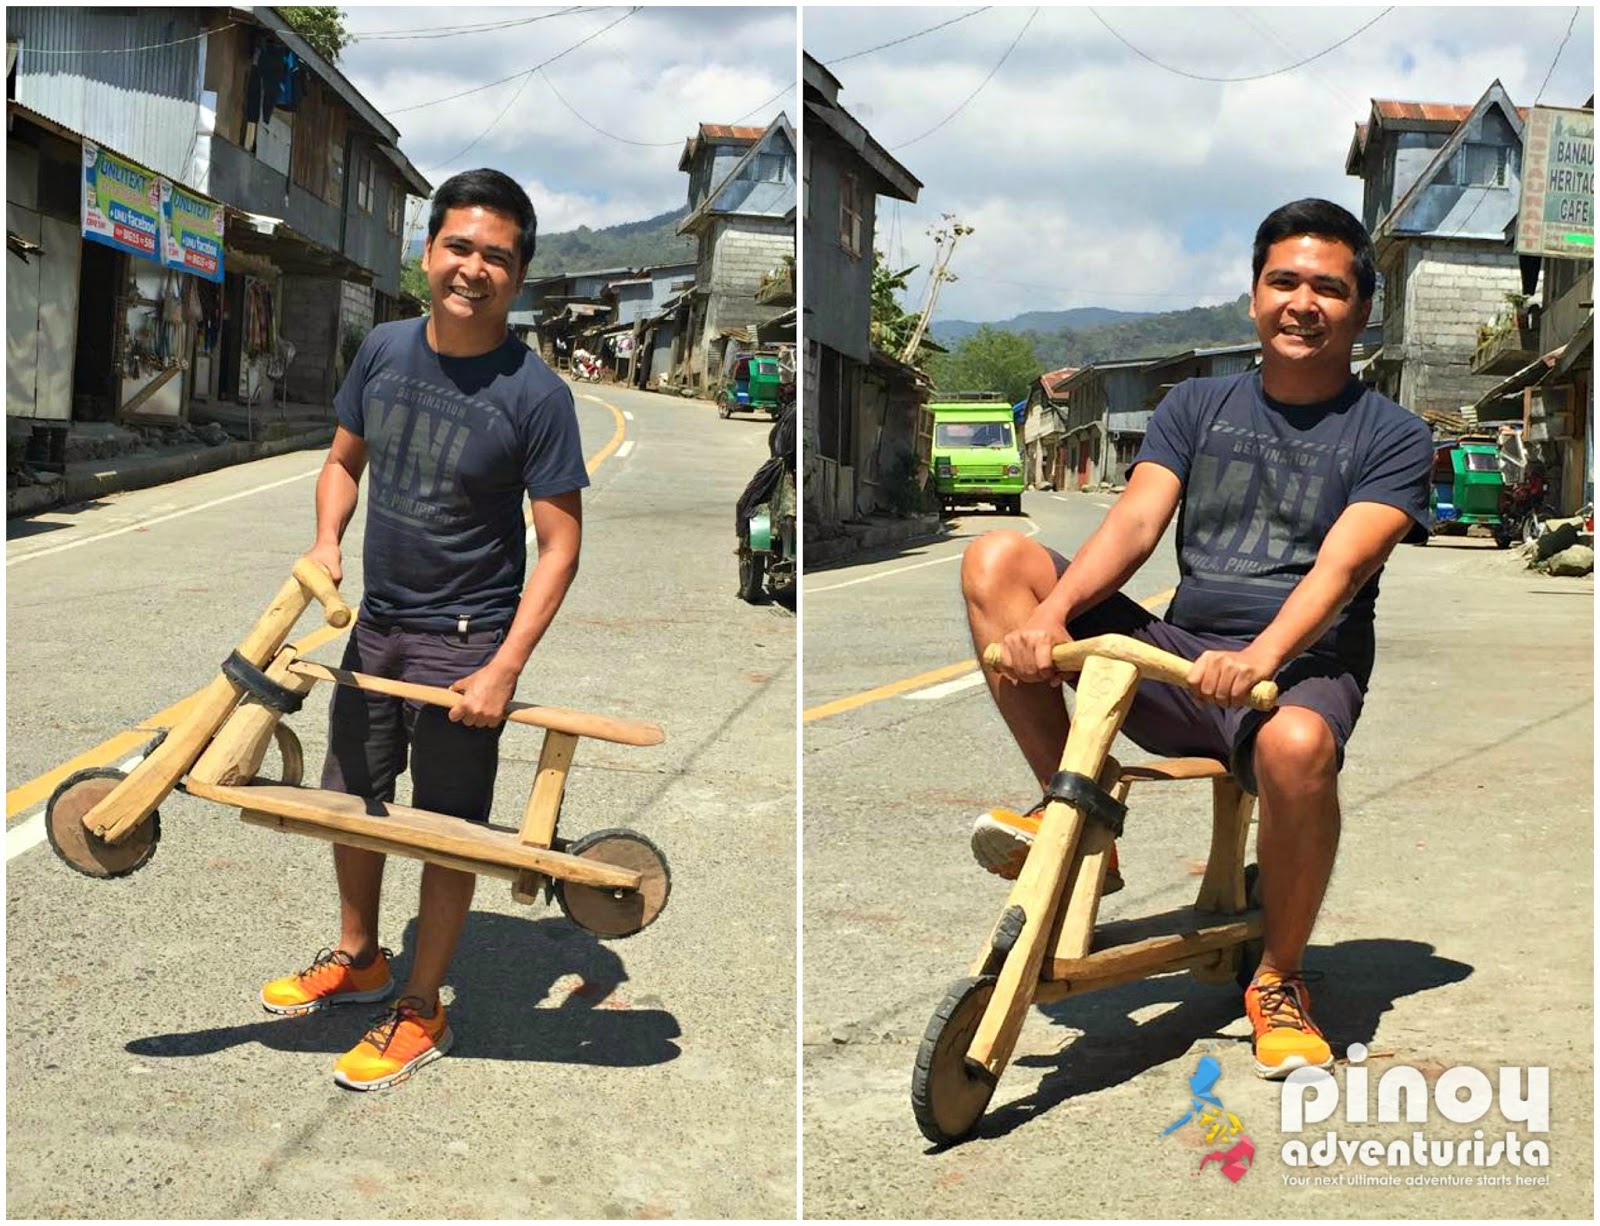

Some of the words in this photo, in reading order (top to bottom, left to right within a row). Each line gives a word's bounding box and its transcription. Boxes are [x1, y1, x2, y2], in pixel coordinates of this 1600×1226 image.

[101, 158, 146, 192] UNLITEXT
[1560, 198, 1589, 223] CAFE
[1232, 440, 1319, 468] DESTINATION
